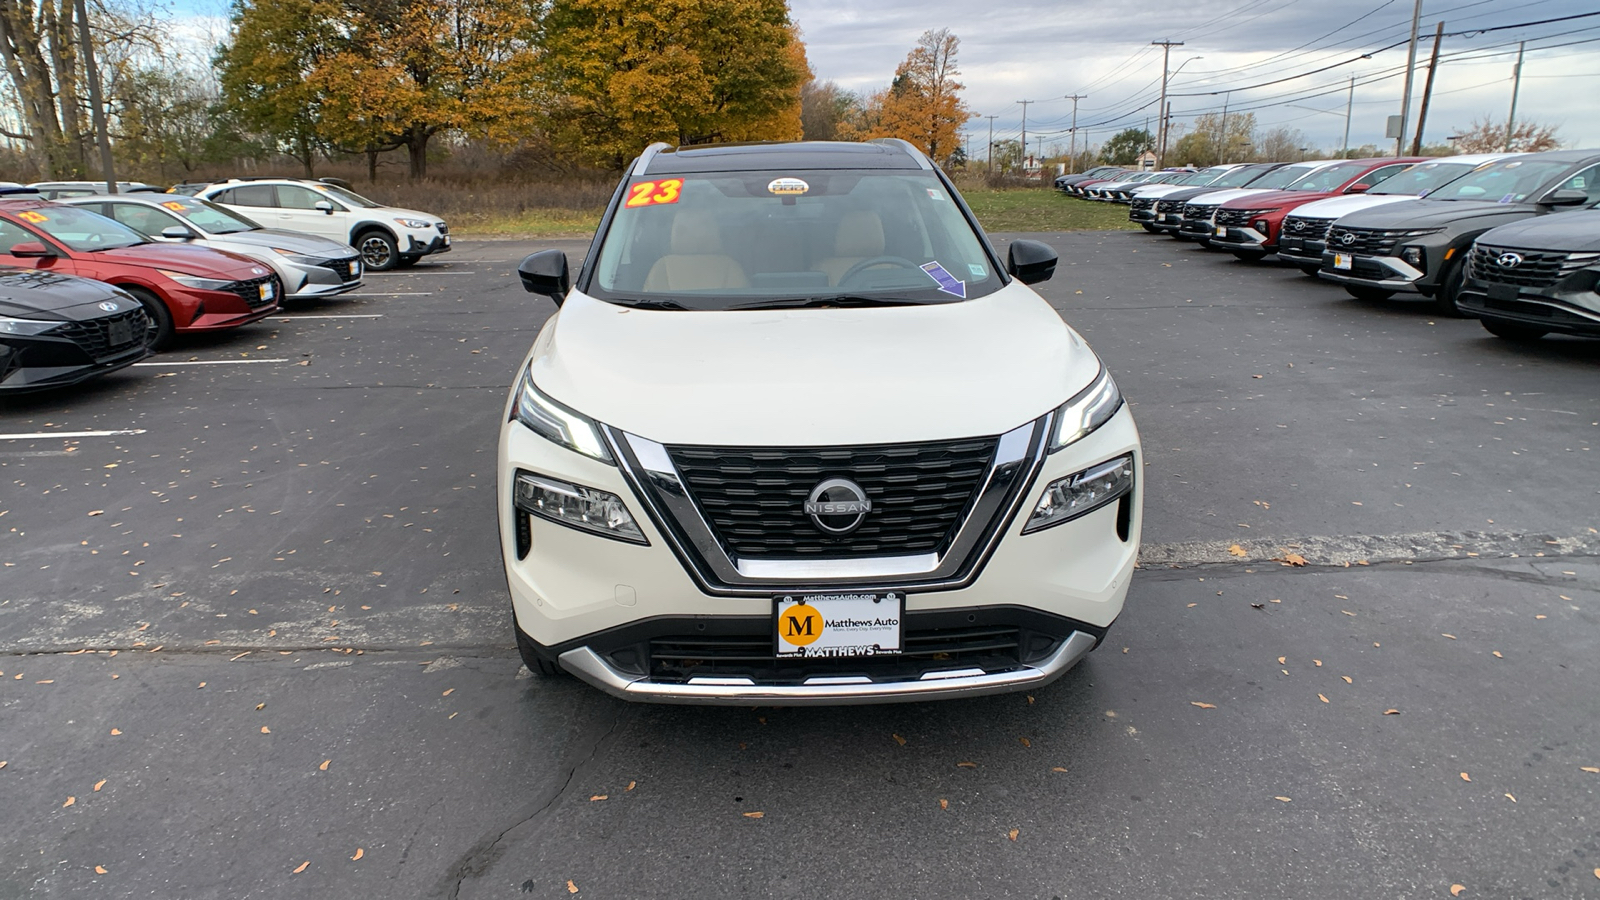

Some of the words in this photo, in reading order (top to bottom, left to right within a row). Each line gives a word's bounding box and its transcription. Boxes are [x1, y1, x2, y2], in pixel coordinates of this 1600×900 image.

[627, 179, 683, 206] 23
[806, 502, 870, 513] NISSAN
[787, 615, 815, 636] M
[825, 618, 872, 628] Matthews
[874, 617, 898, 626] Auto
[804, 645, 874, 658] MATTHEWS
